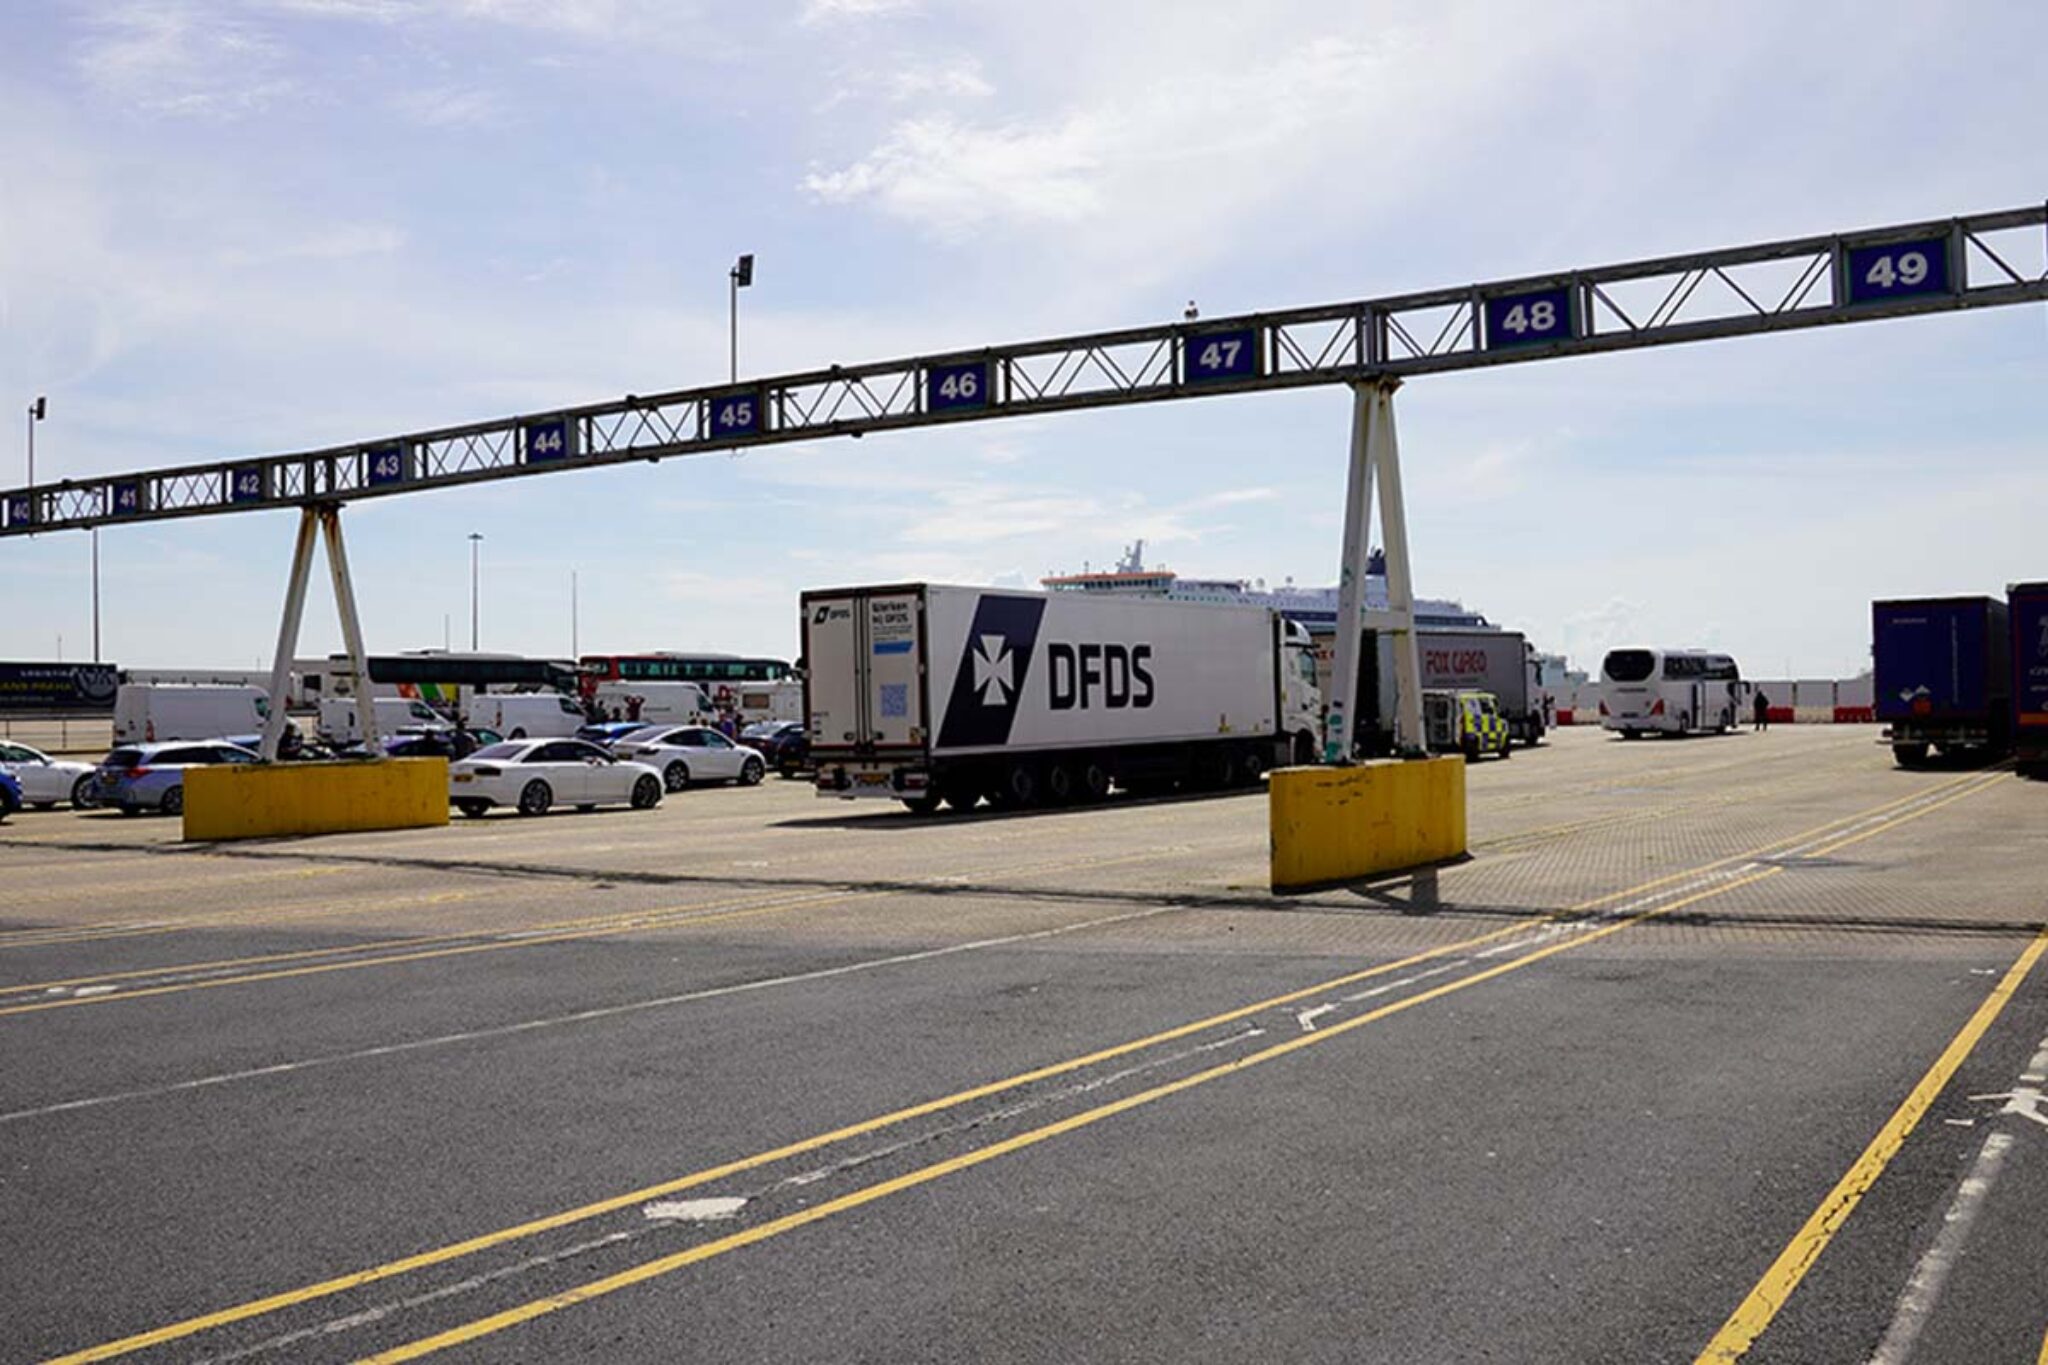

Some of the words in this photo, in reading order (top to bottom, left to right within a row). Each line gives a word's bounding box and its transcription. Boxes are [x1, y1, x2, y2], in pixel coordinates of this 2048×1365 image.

[1866, 252, 1928, 287] 49
[1503, 300, 1556, 333] 48
[1200, 341, 1240, 370] 47
[940, 373, 976, 399] 46
[720, 402, 751, 427] 45
[534, 430, 562, 452] 44
[376, 455, 399, 477] 43
[238, 474, 259, 494] 42
[120, 489, 136, 507] 41
[1048, 643, 1154, 710] DFDS
[1425, 652, 1449, 676] FOX
[1453, 652, 1488, 674] CARGO
